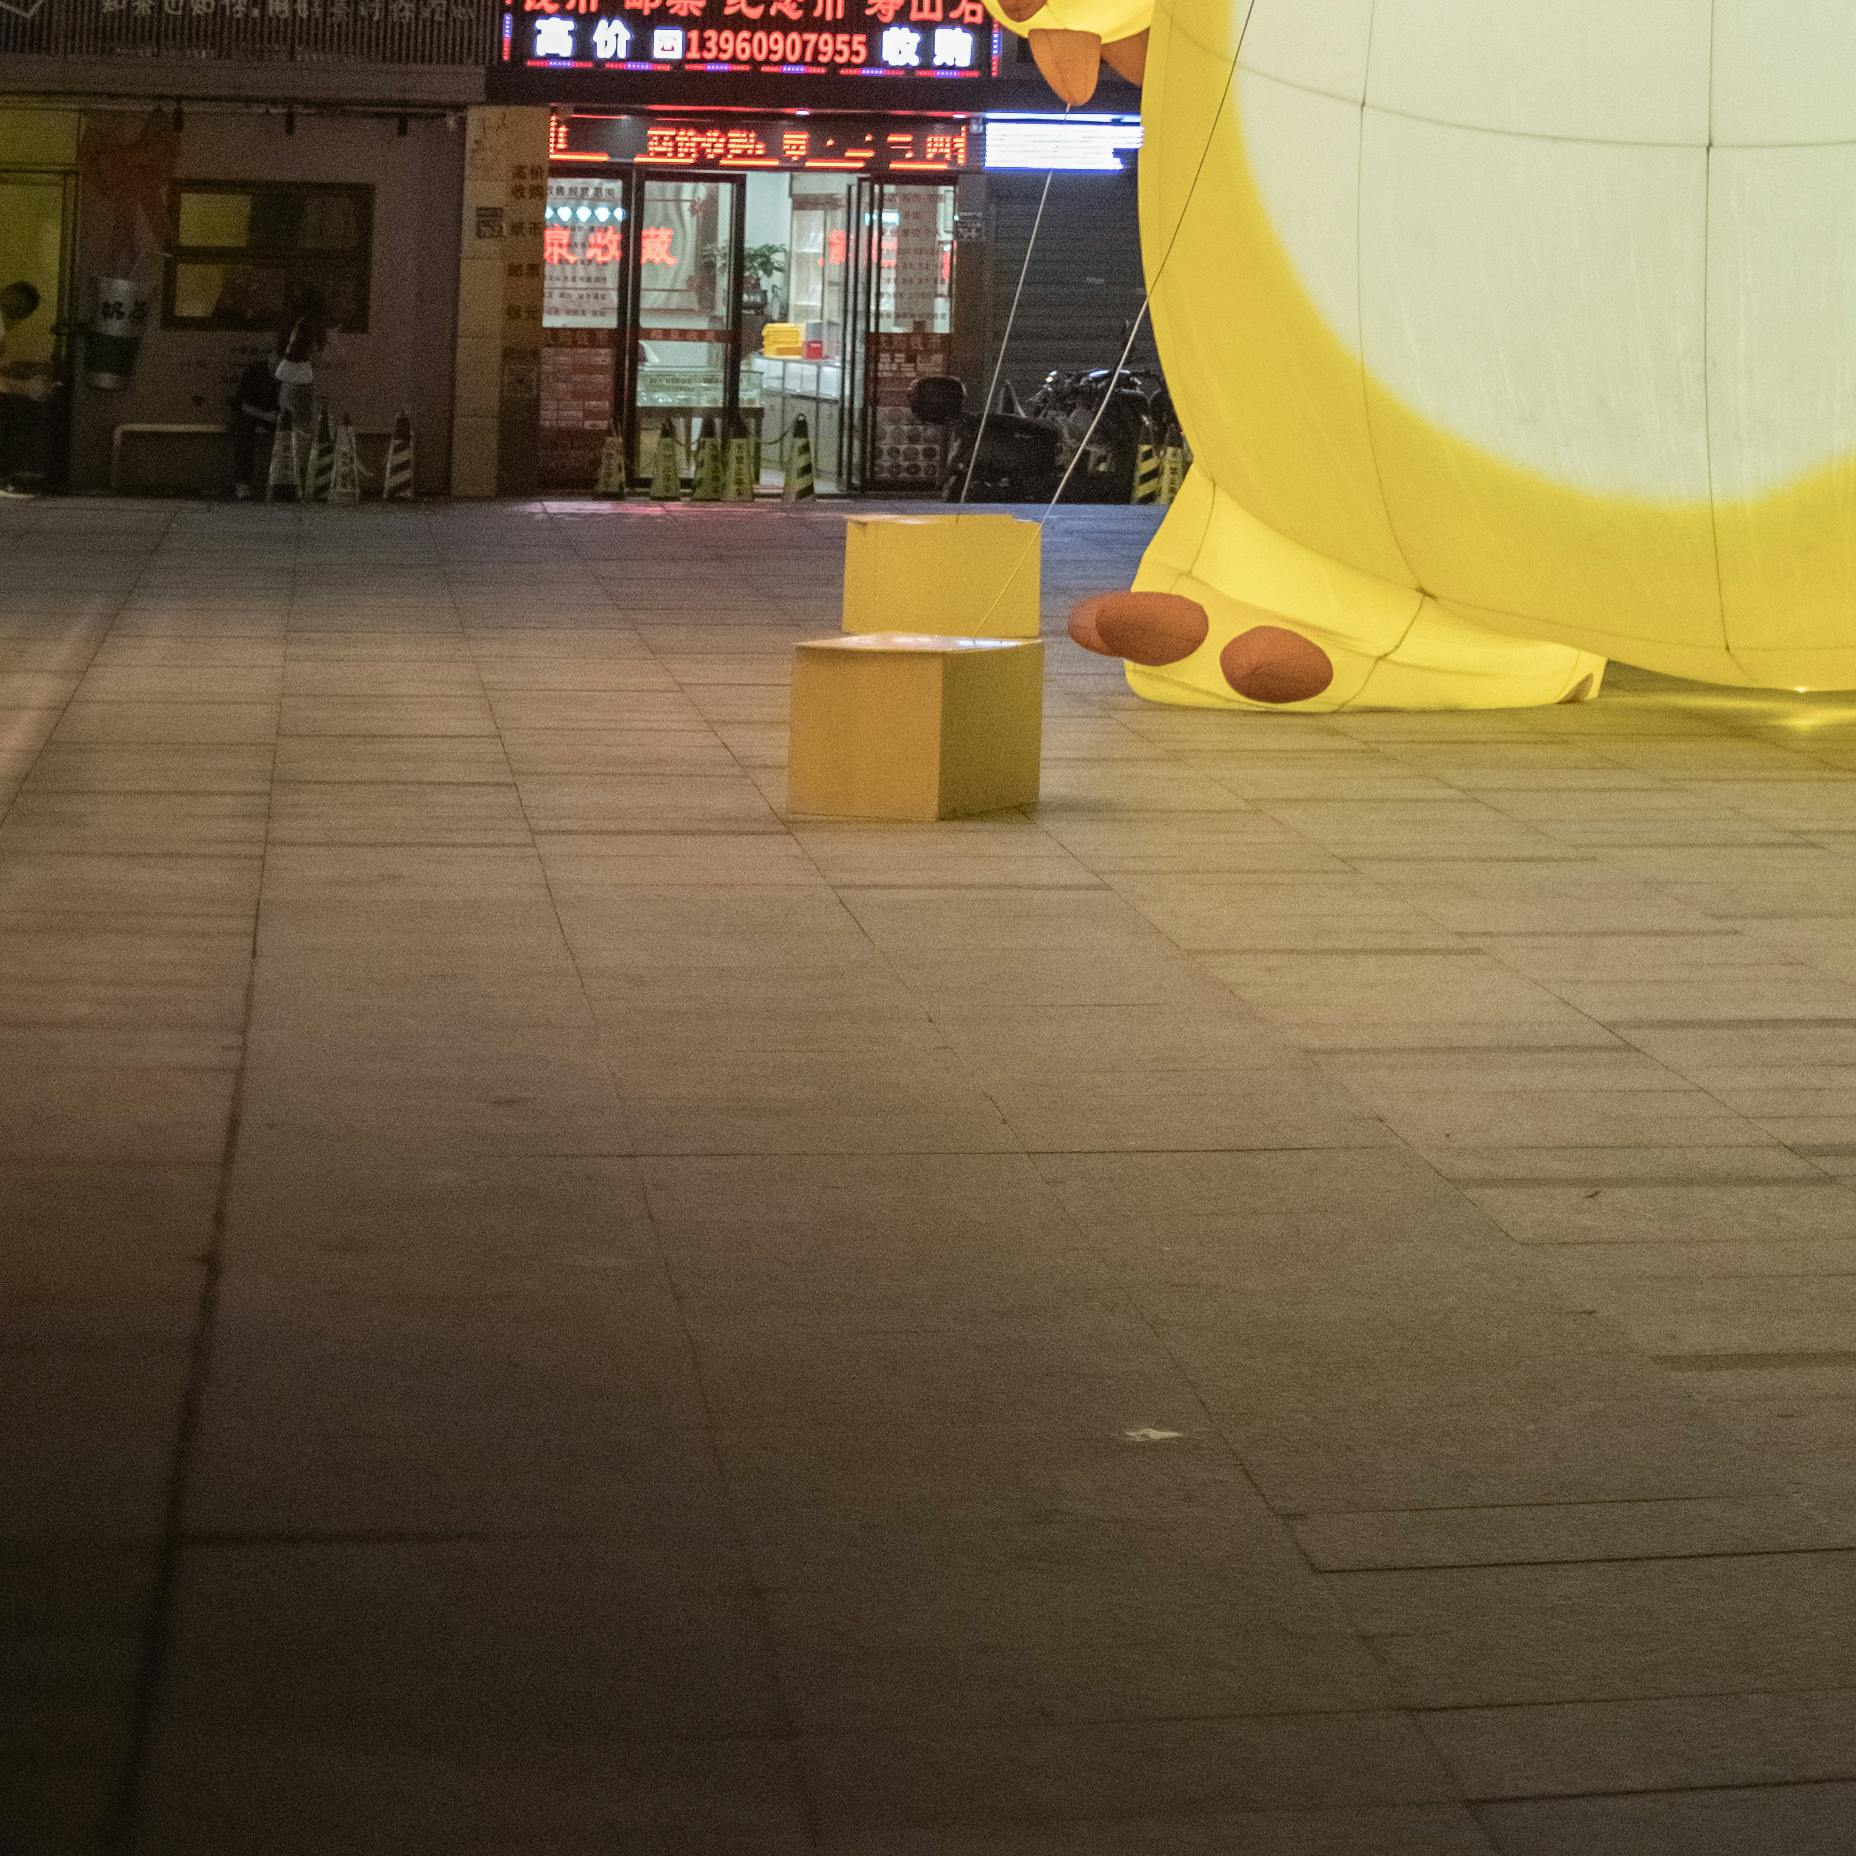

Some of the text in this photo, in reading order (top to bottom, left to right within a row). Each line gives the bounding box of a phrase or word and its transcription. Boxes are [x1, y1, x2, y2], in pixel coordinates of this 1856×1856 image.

[533, 17, 974, 67] 高价 13960907955 收购
